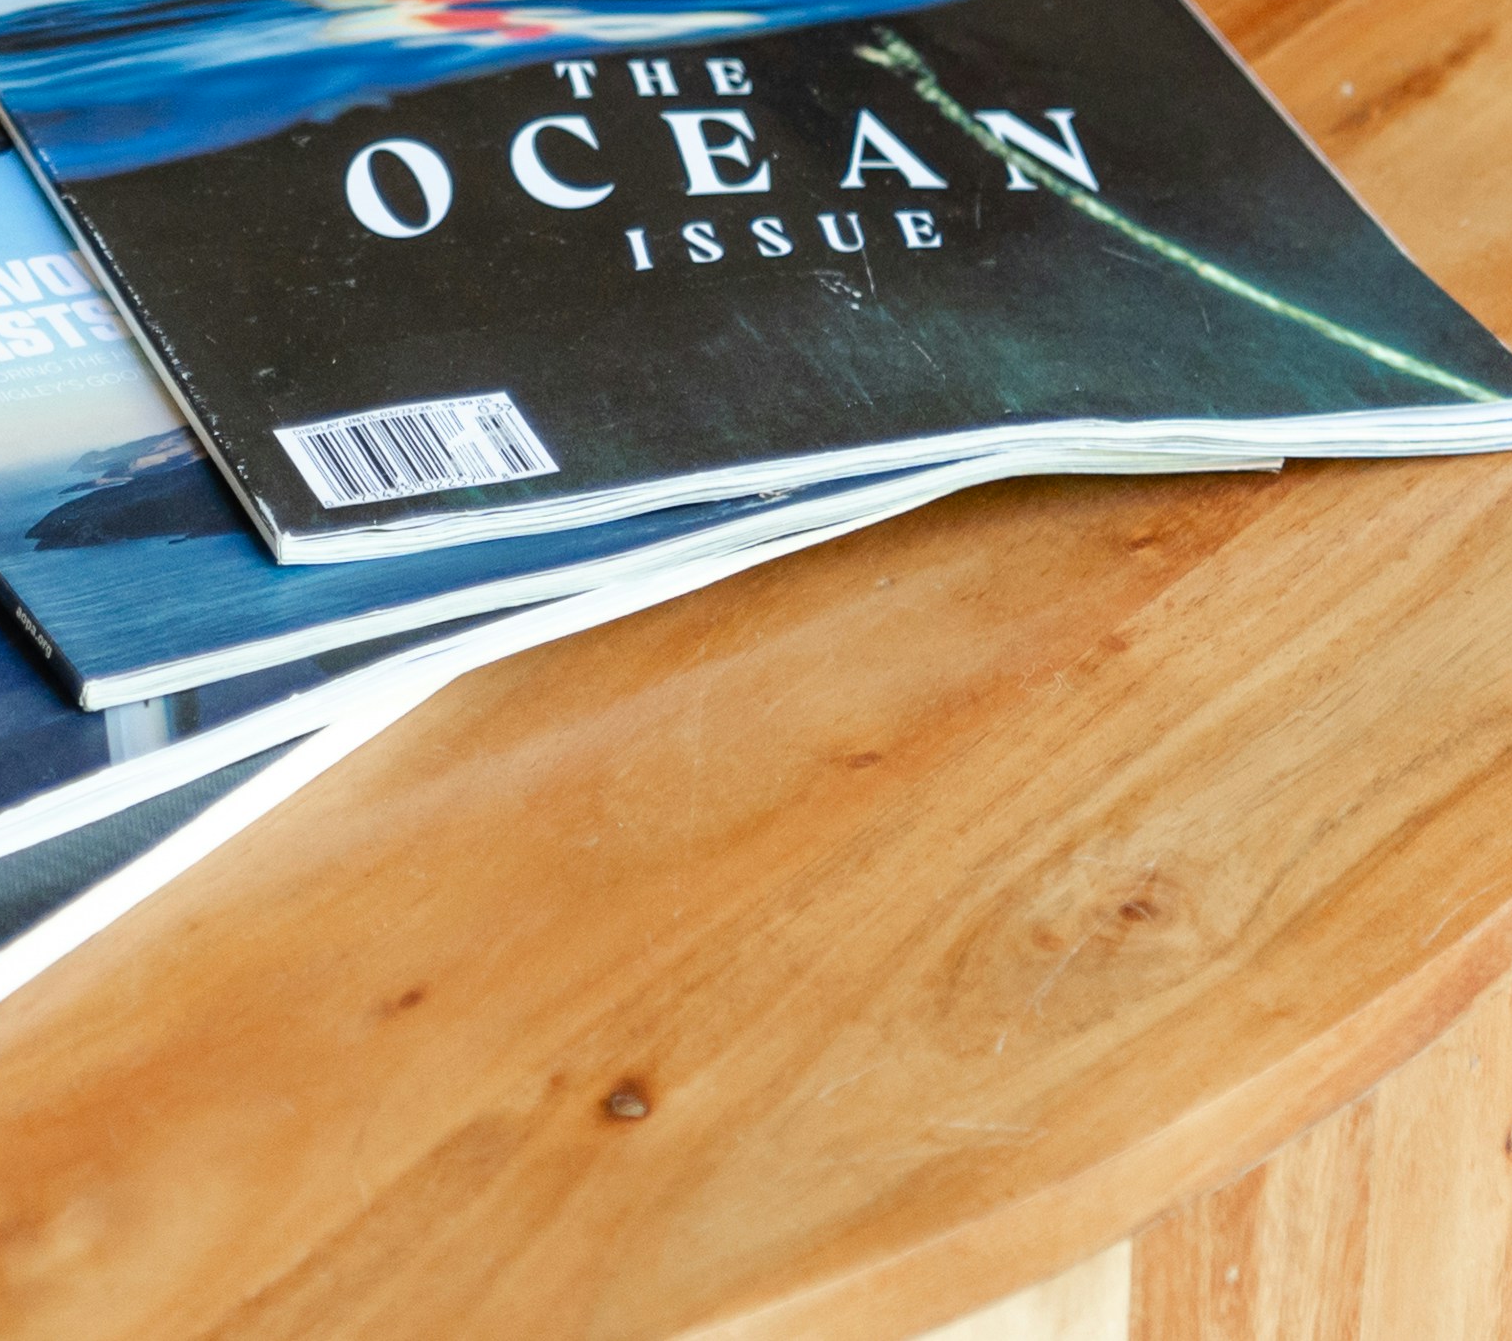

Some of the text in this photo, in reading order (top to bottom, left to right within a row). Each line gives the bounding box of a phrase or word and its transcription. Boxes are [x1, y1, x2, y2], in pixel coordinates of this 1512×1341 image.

[555, 59, 754, 98] THE
[344, 107, 1100, 240] OCEAN
[625, 209, 944, 272] ISSUE
[65, 351, 111, 372] THE
[292, 421, 340, 436] DISPLAY
[344, 413, 380, 427] UNTIL
[14, 604, 54, 660] aopa.org
